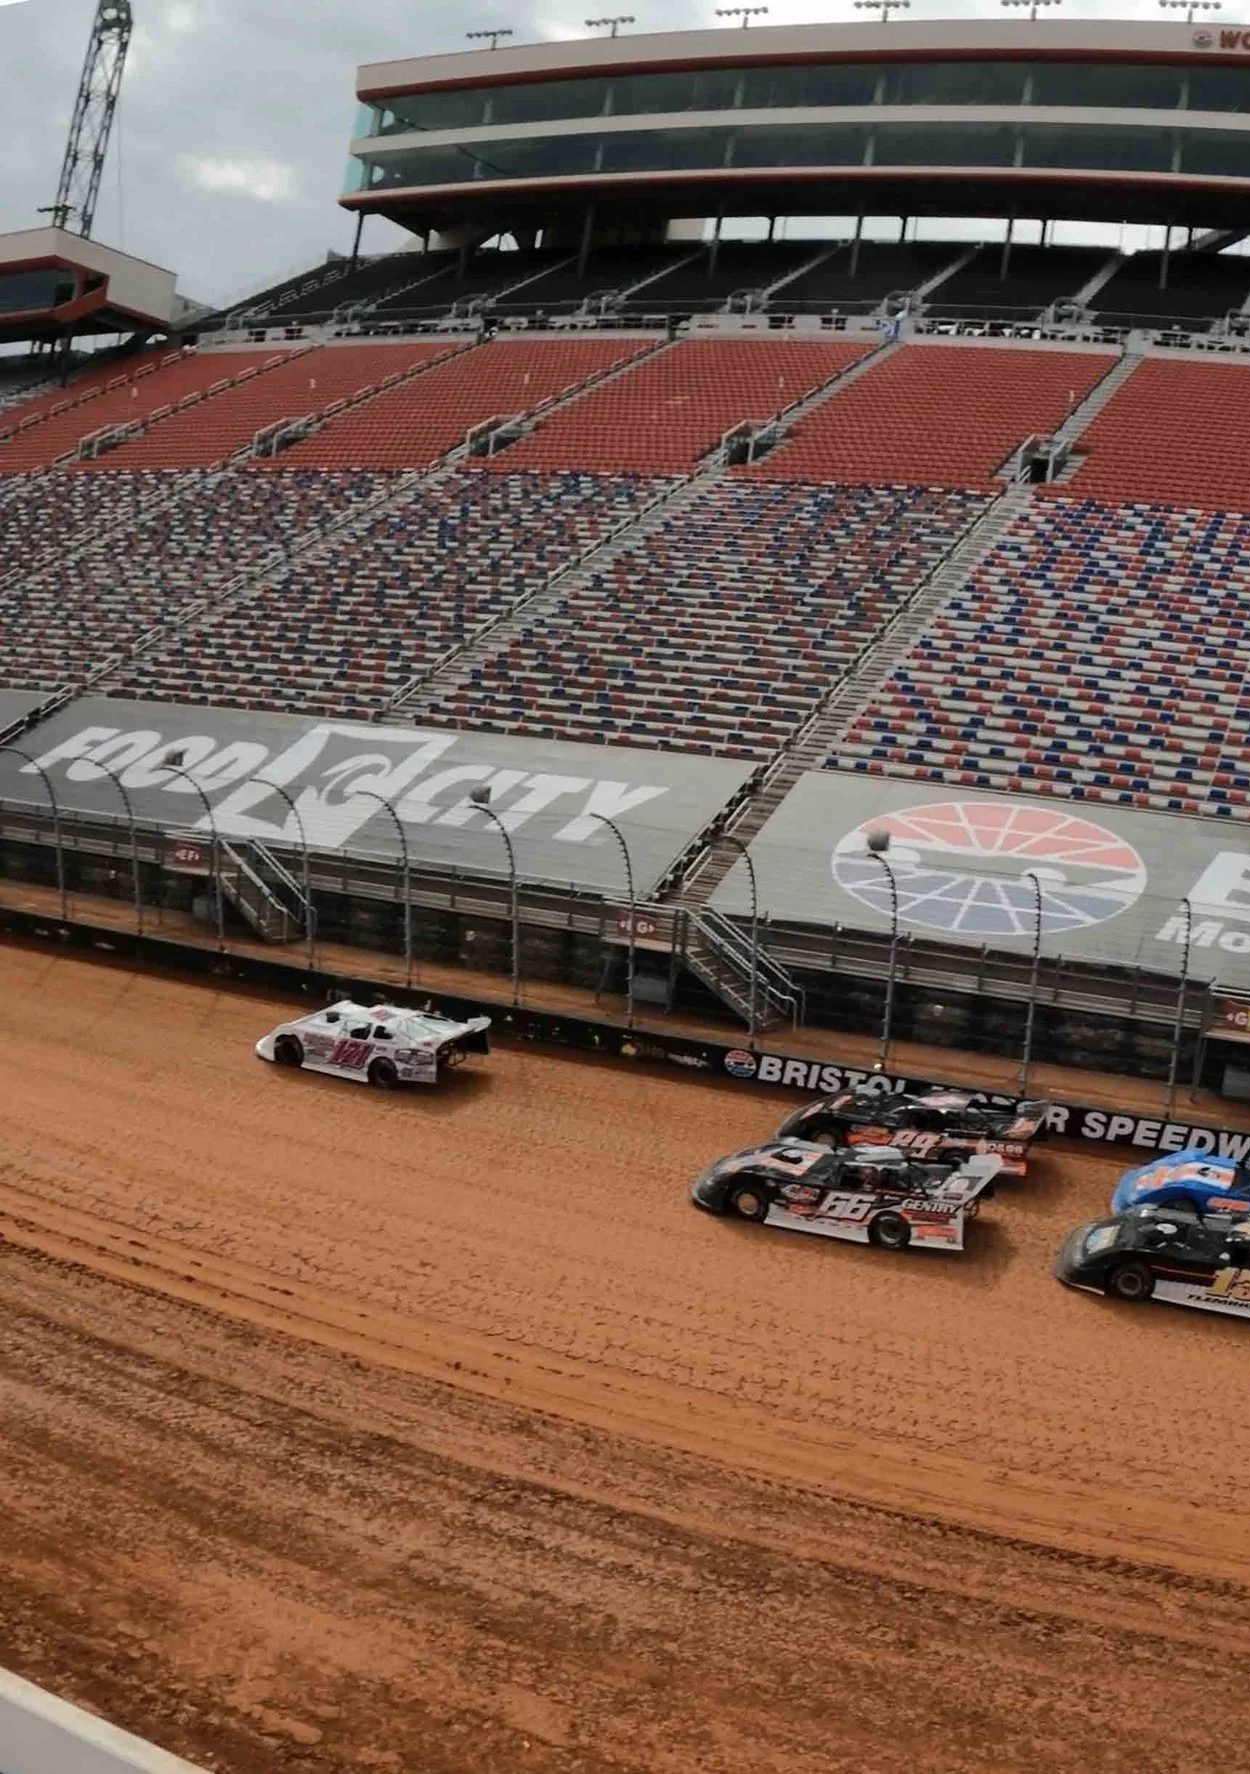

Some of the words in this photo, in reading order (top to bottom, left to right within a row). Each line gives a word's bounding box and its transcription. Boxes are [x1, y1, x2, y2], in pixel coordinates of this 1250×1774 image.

[19, 726, 268, 794] FOOD
[398, 764, 670, 842] CITY
[816, 1189, 878, 1221] 66
[901, 1198, 961, 1214] GENTRY
